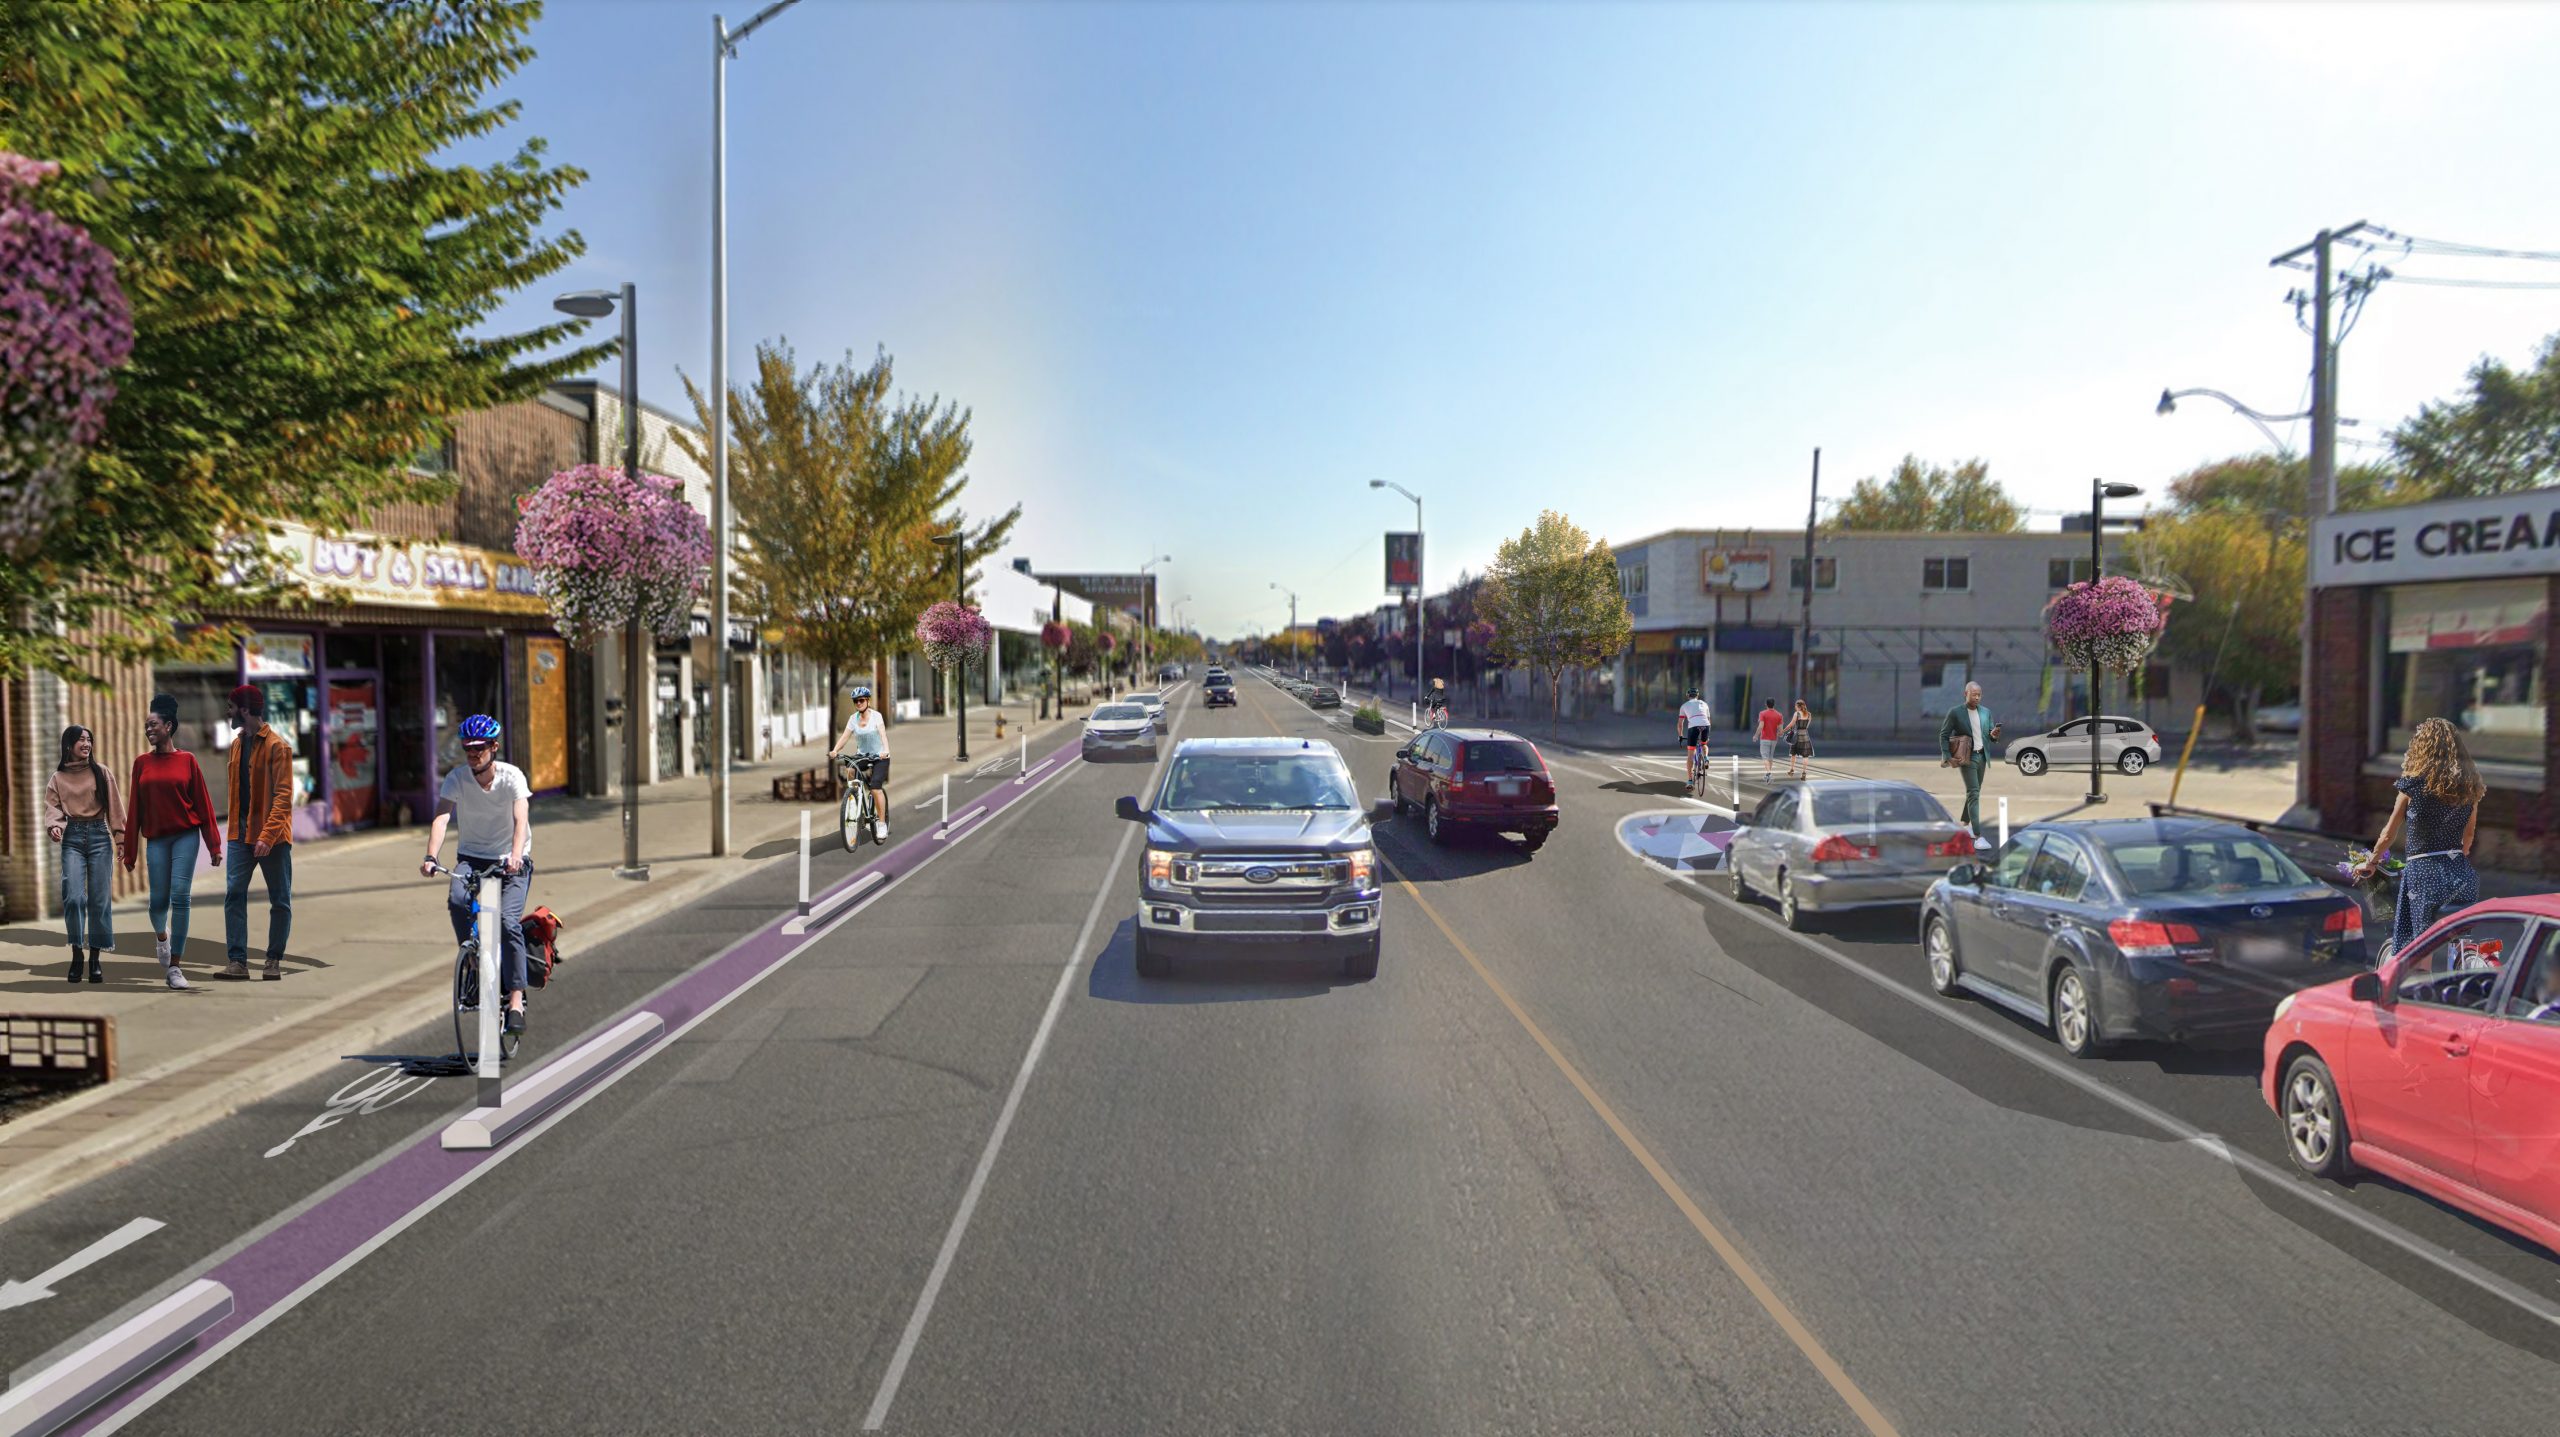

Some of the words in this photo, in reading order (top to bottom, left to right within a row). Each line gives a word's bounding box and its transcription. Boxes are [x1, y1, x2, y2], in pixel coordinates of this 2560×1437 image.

[314, 537, 379, 578] BUY
[391, 551, 413, 588] &
[424, 553, 488, 590] SELL
[2333, 526, 2396, 565] ICE
